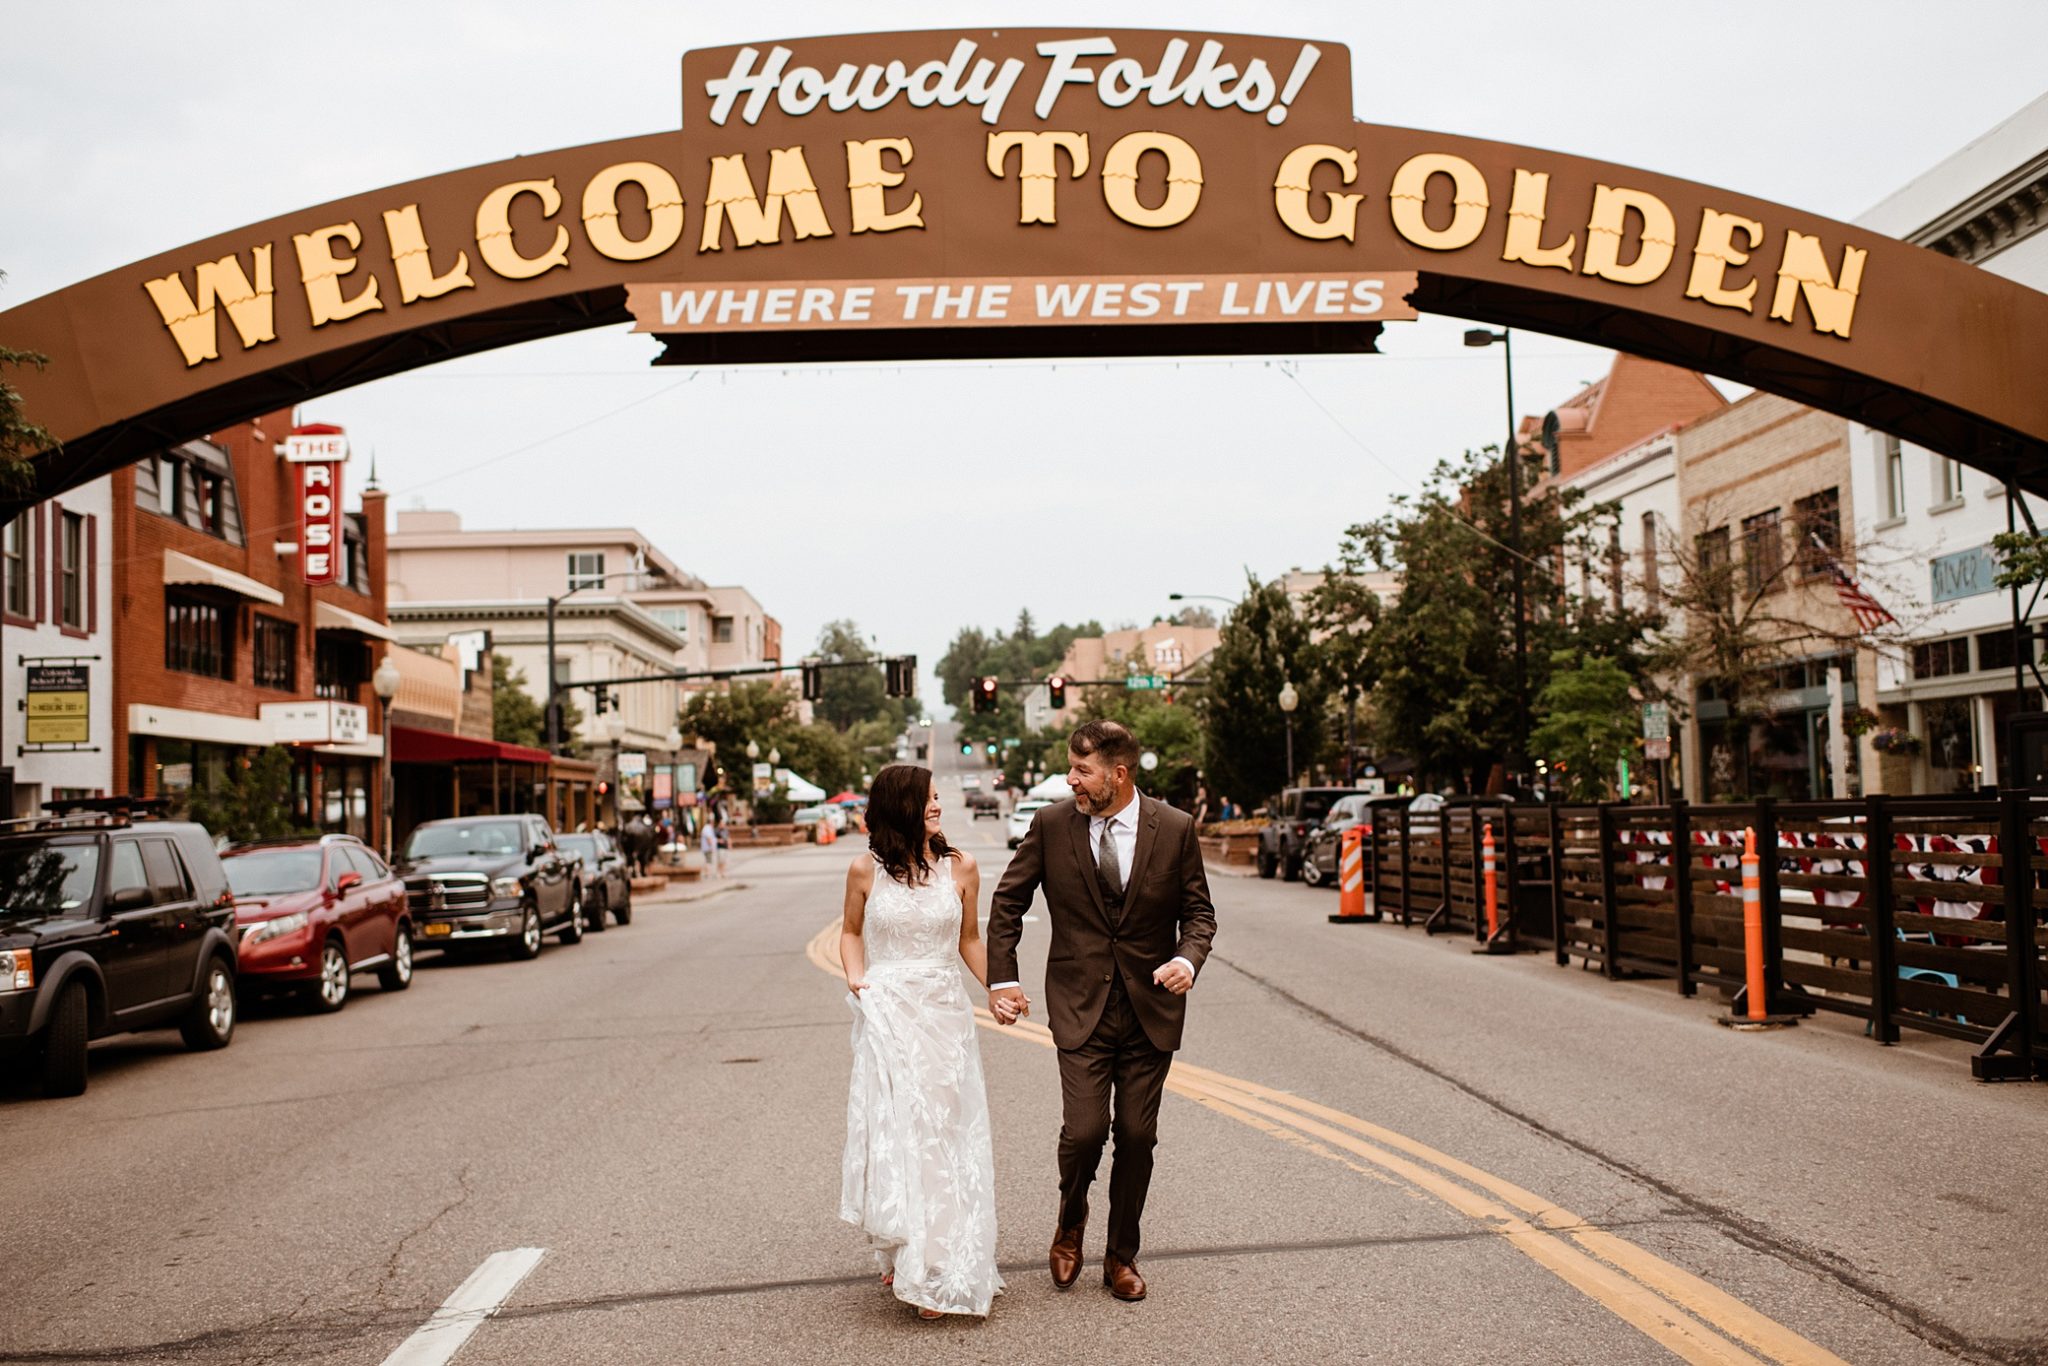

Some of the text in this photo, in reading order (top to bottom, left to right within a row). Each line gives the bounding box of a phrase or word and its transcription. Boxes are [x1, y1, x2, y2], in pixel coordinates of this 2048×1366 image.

[705, 36, 1321, 126] Howdy Folks!
[144, 131, 1870, 368] WELCOME TO GOLDEN
[659, 279, 1386, 325] WHERE THE WEST LIVES
[292, 440, 341, 456] THE
[305, 465, 332, 576] ROSE
